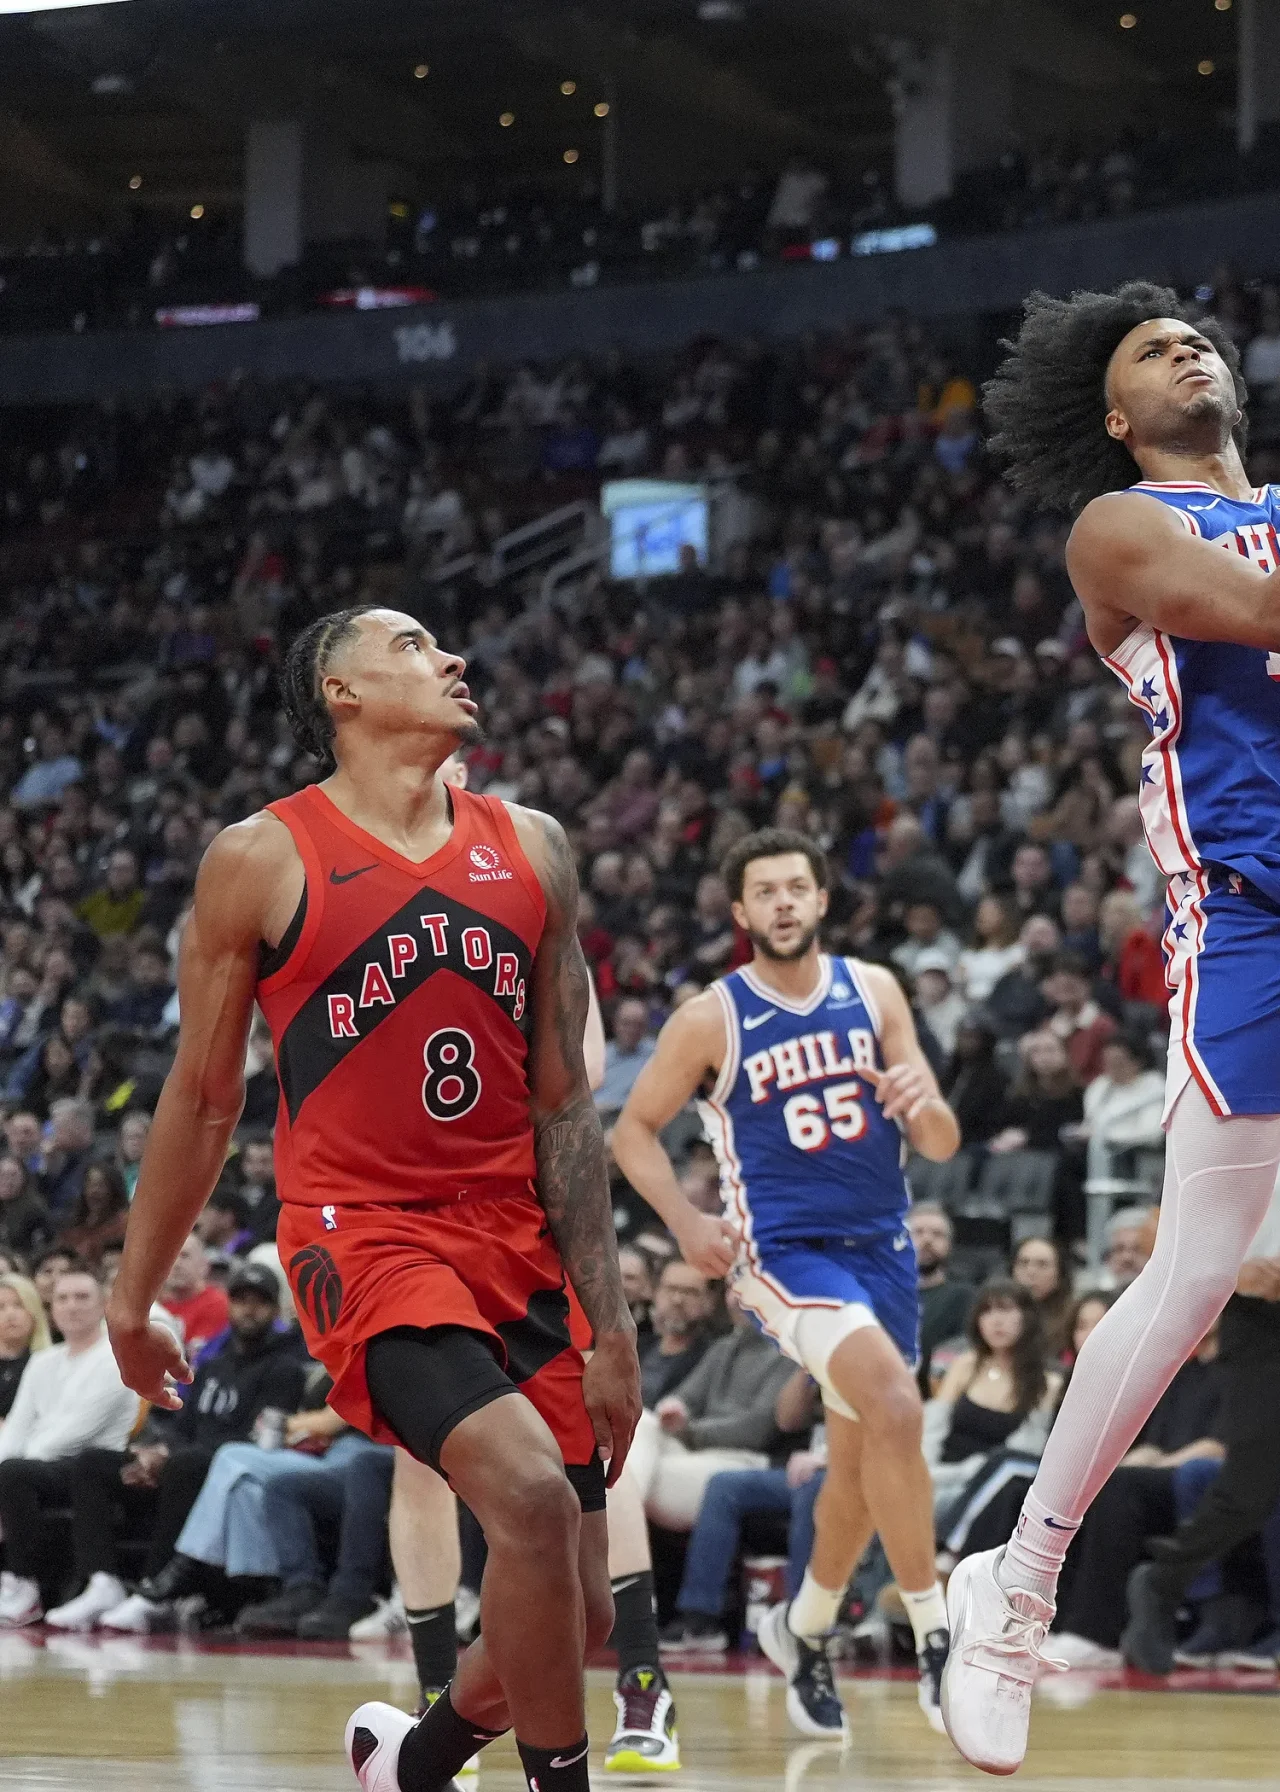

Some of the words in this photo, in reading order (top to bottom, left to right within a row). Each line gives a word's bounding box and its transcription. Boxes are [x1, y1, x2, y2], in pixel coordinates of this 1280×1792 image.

[469, 872, 492, 882] Sun
[491, 869, 513, 880] Life
[327, 913, 526, 1038] RAPTORS
[421, 1027, 482, 1122] 8
[743, 1028, 877, 1105] PHILA
[783, 1082, 868, 1154] 65
